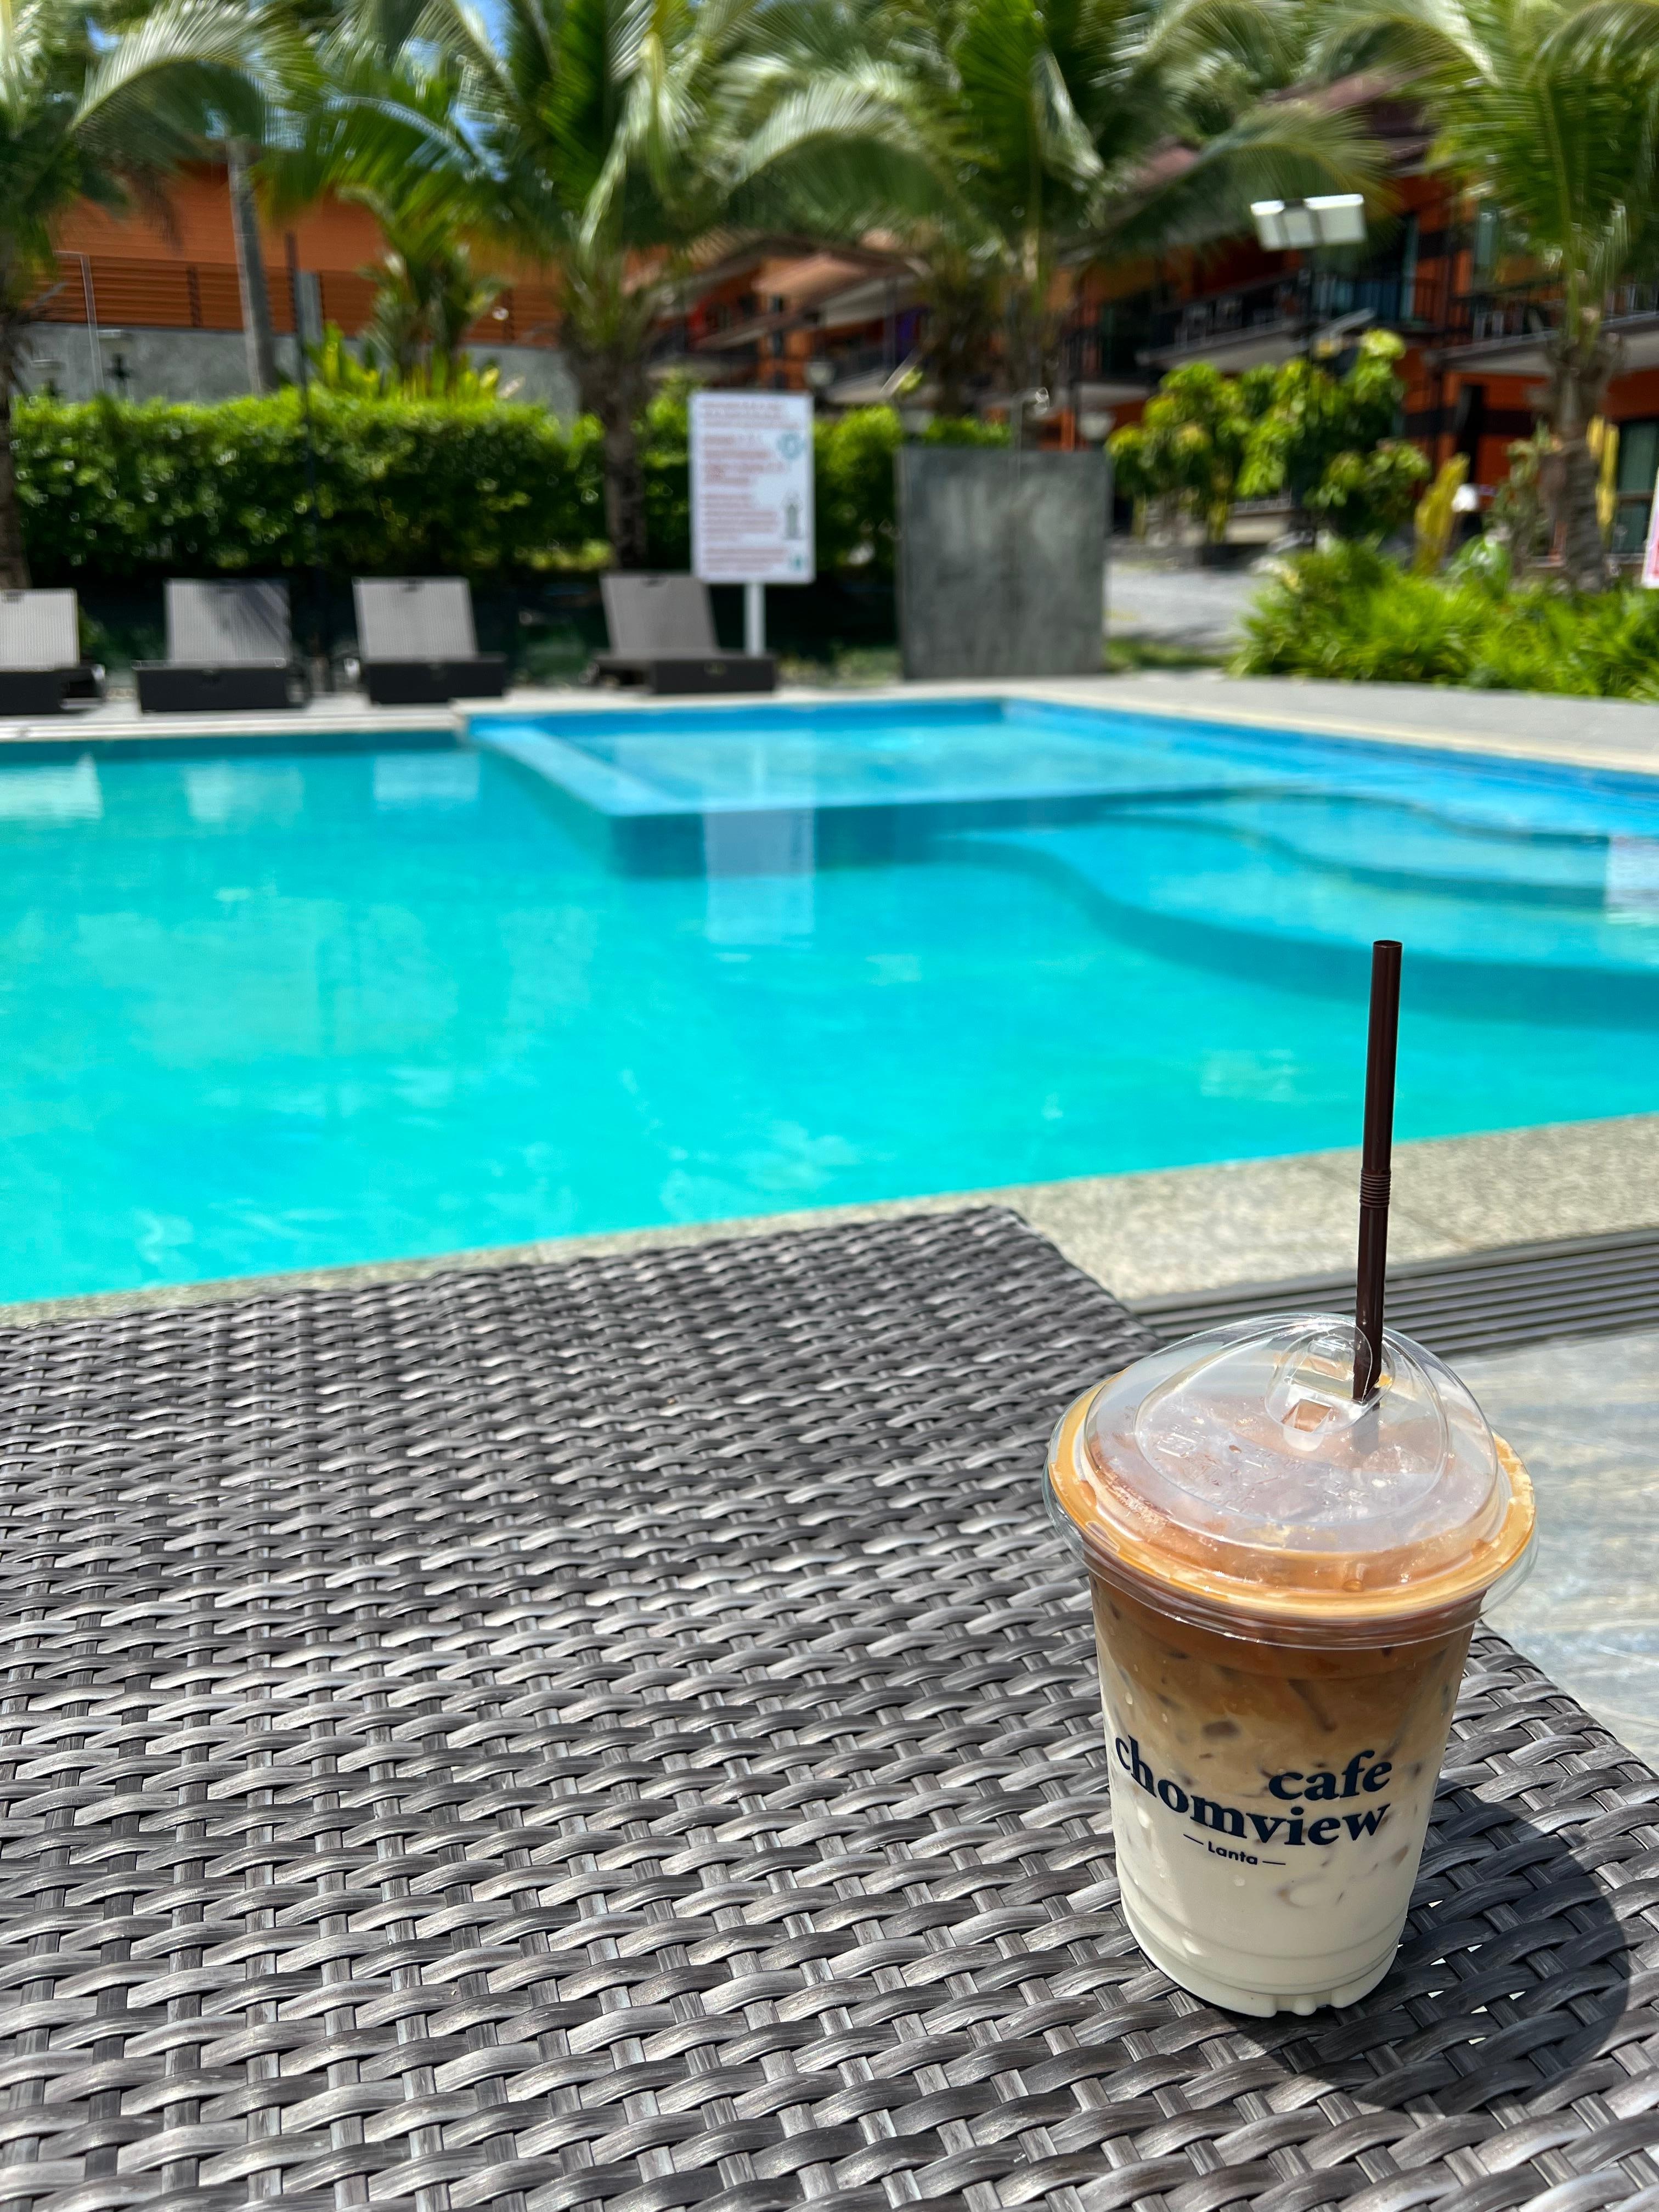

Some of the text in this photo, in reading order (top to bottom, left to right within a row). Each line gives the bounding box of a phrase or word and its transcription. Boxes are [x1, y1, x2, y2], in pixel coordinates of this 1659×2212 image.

[1115, 1735, 1391, 1846] chomview
[1268, 1750, 1392, 1801] cafe
[1207, 1841, 1258, 1865] Lanta
